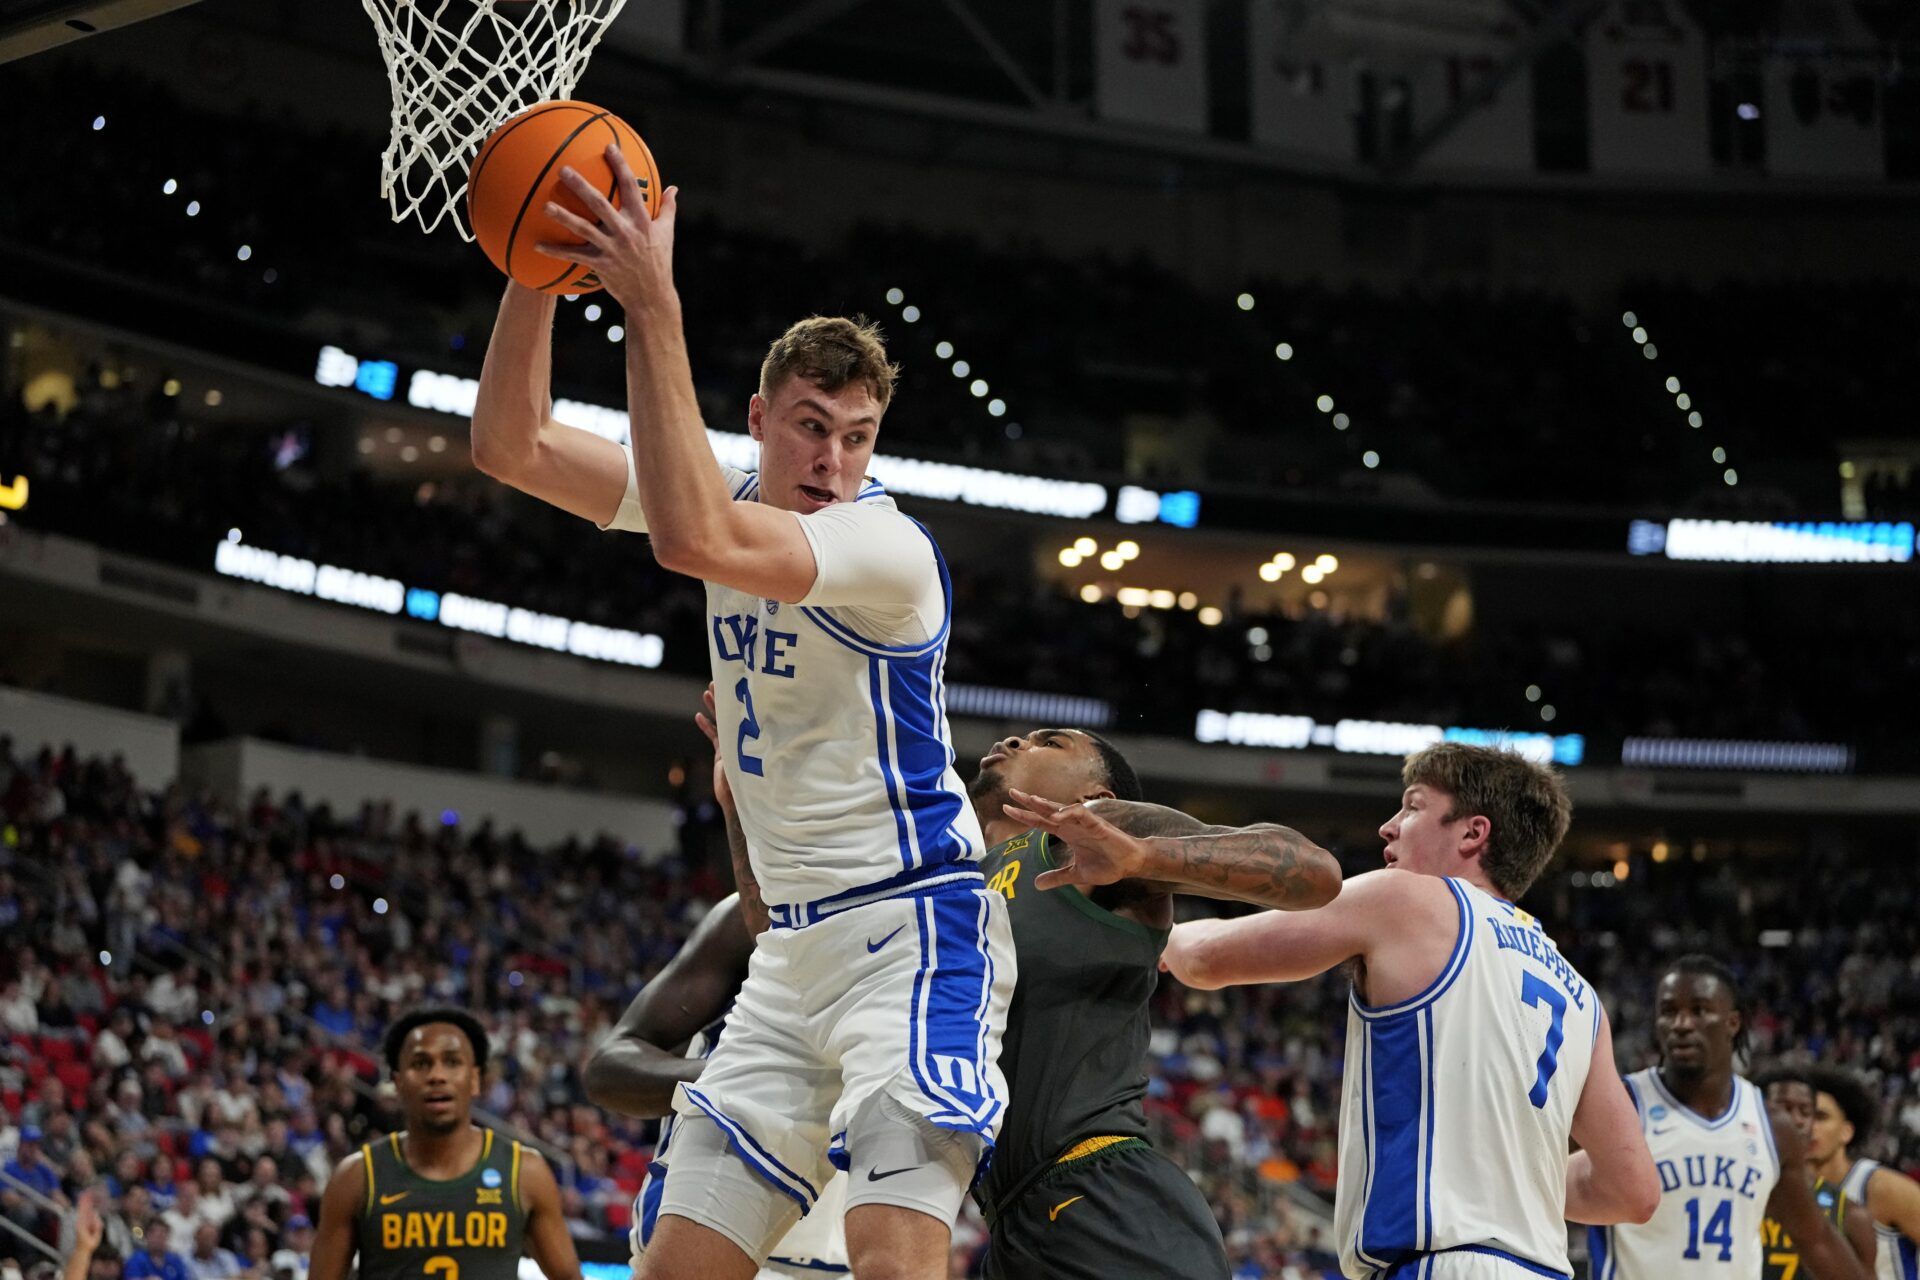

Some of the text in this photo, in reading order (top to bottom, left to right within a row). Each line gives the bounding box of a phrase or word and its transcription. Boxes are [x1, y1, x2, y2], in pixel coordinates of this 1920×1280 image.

[1621, 57, 1676, 113] 21
[713, 614, 798, 678] UKE
[735, 677, 764, 777] 2
[1521, 969, 1567, 1110] 7
[1656, 1155, 1762, 1200] DUKE
[382, 1211, 508, 1249] BAYLOR
[1683, 1197, 1734, 1262] 14
